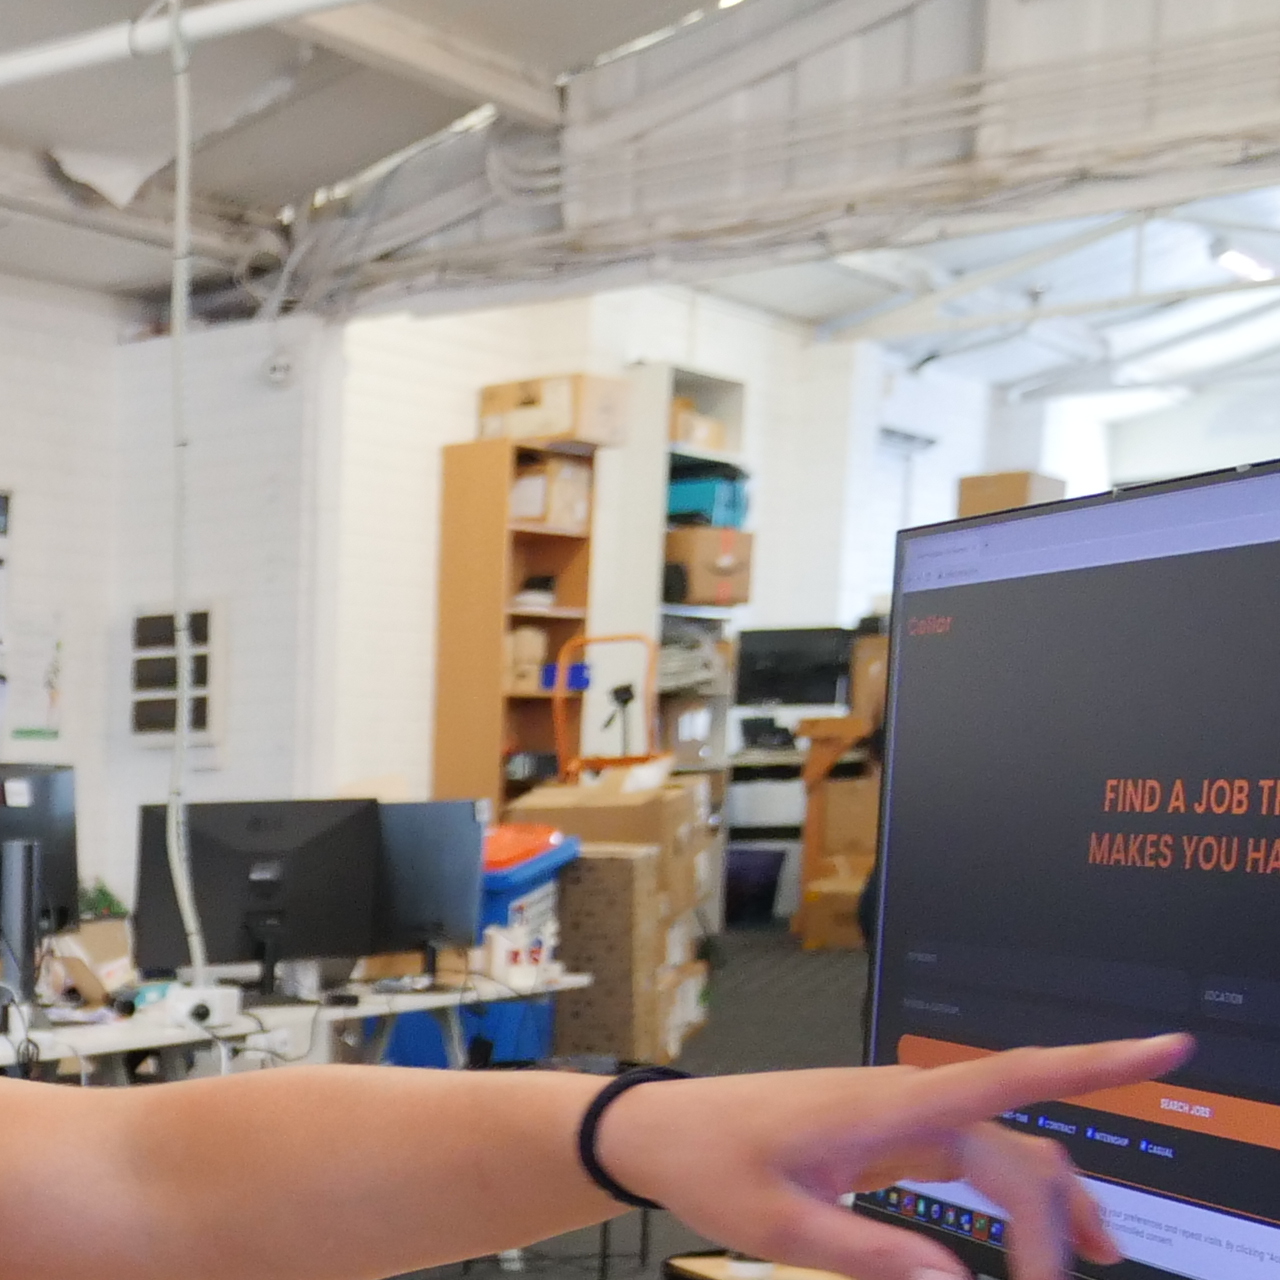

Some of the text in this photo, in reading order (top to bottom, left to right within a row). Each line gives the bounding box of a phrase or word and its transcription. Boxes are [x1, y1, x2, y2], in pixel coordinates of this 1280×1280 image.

[1103, 778, 1162, 813] FIND
[1167, 778, 1186, 813] A
[1193, 778, 1250, 815] JOB
[1088, 832, 1175, 868] MAKES
[1182, 835, 1240, 872] YOU
[1160, 1098, 1214, 1119] SEARCH JOBS
